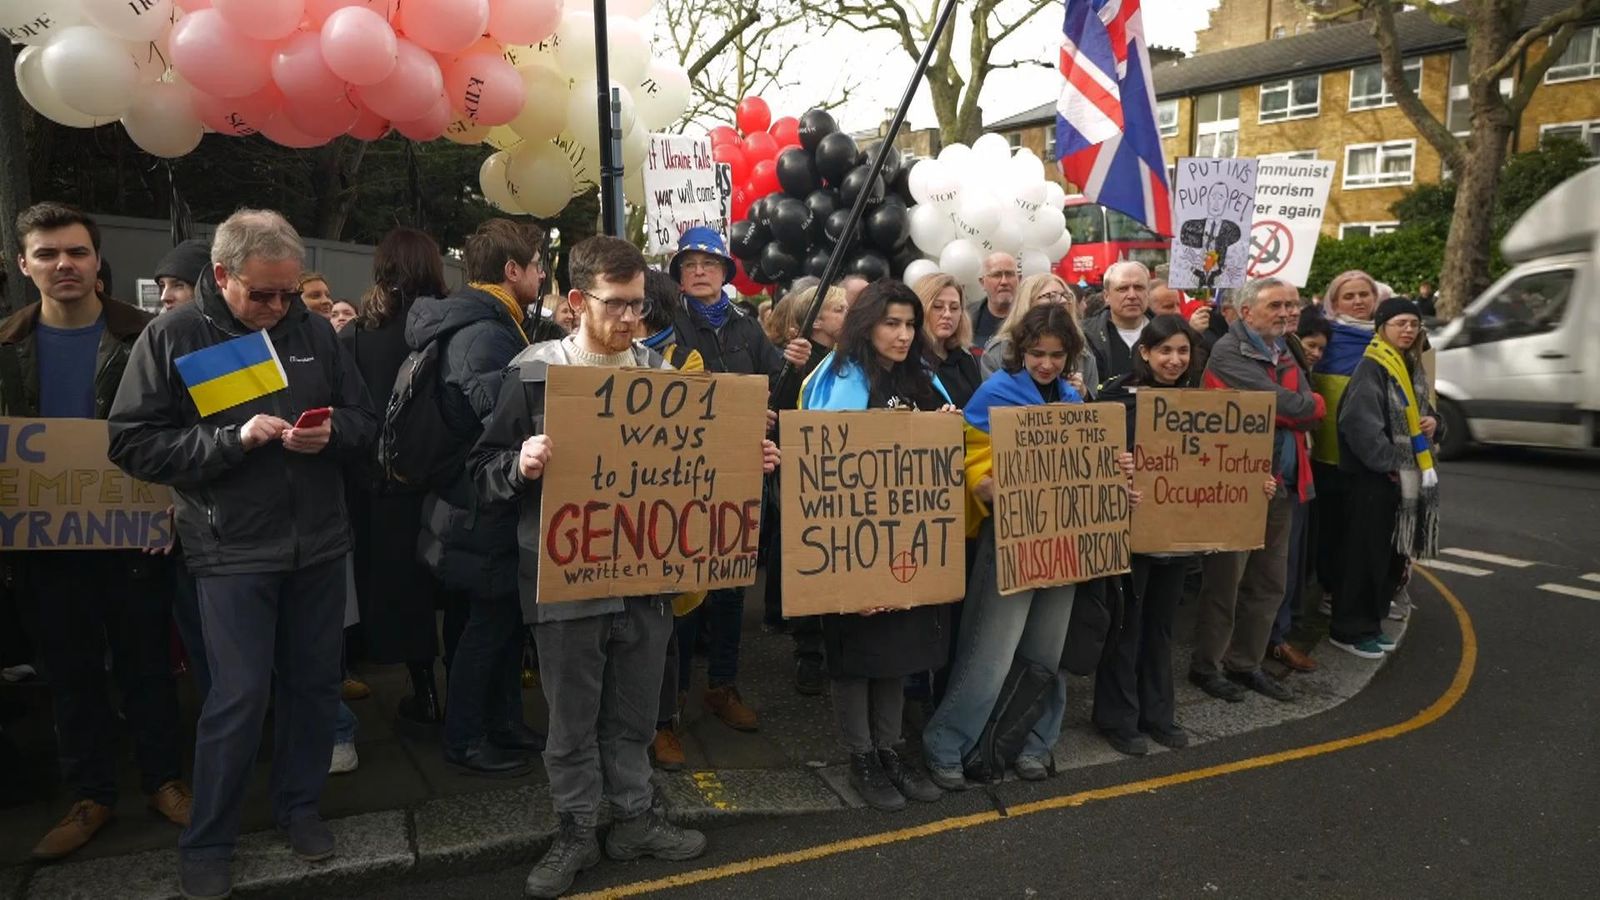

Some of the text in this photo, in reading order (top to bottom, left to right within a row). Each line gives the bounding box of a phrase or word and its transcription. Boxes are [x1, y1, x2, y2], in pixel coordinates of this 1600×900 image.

[1257, 164, 1329, 178] mmunist
[1256, 183, 1314, 197] rrorism
[1253, 203, 1321, 220] er again
[655, 220, 670, 246] to
[595, 373, 717, 420] 1001
[1016, 410, 1099, 427] WHILE YOU'RE
[1153, 396, 1272, 434] Peace Deal
[620, 424, 706, 451] WAYS
[799, 422, 849, 455] TRY
[1015, 428, 1107, 447] READING THIS
[1181, 434, 1201, 455] is
[799, 443, 966, 494] NEGOTIATING
[997, 445, 1121, 489] UKRAINIANS ARE
[1133, 444, 1179, 472] Death
[1214, 443, 1272, 474] Torture
[591, 454, 716, 502] to justify
[1154, 476, 1248, 508] Occupation
[799, 487, 951, 519] WHILE BEING
[1000, 483, 1129, 540] BEING TORTURED
[546, 497, 762, 567] GENOCIDE
[796, 516, 957, 575] SHOT AT
[662, 559, 684, 583] by
[692, 552, 758, 584] TRUMP
[998, 529, 1131, 592] IN RUSSIAN PRISONS
